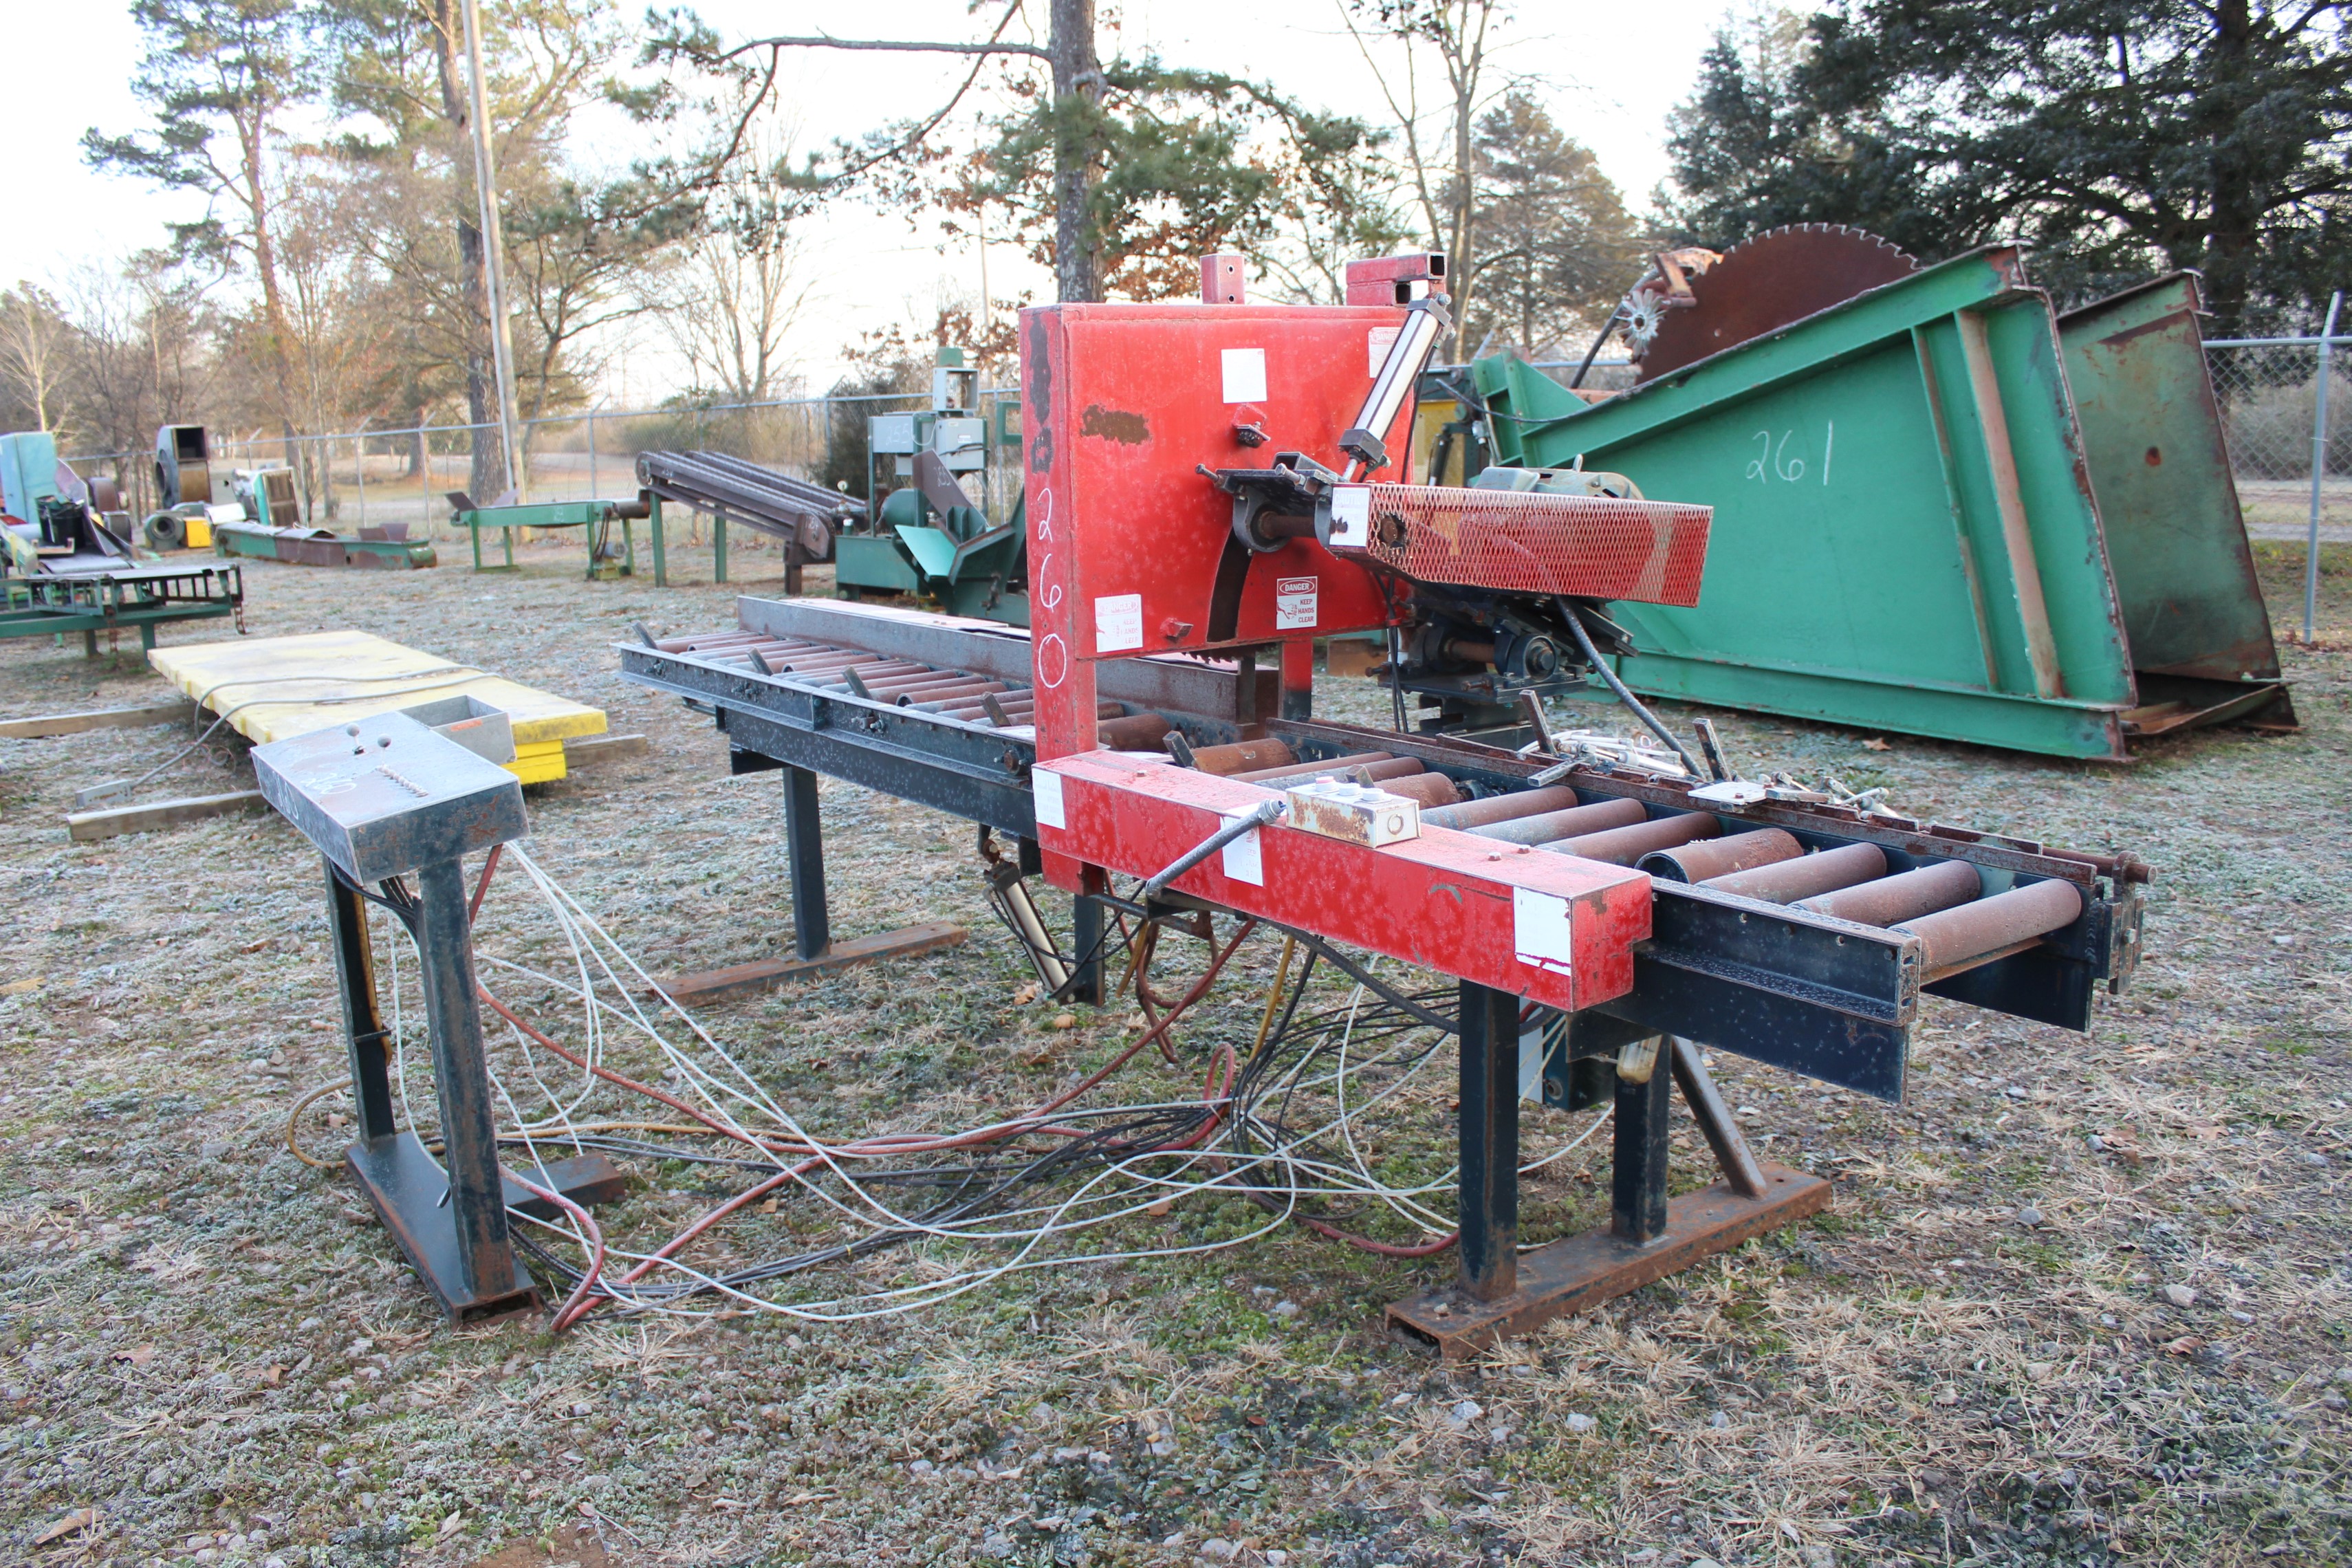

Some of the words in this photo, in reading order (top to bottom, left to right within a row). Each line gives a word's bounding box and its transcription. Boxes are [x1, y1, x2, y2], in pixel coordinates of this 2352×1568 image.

[886, 423, 911, 446] 255
[1745, 420, 1833, 486] 261
[1037, 488, 1067, 688] 260
[1285, 582, 1309, 591] DANGER
